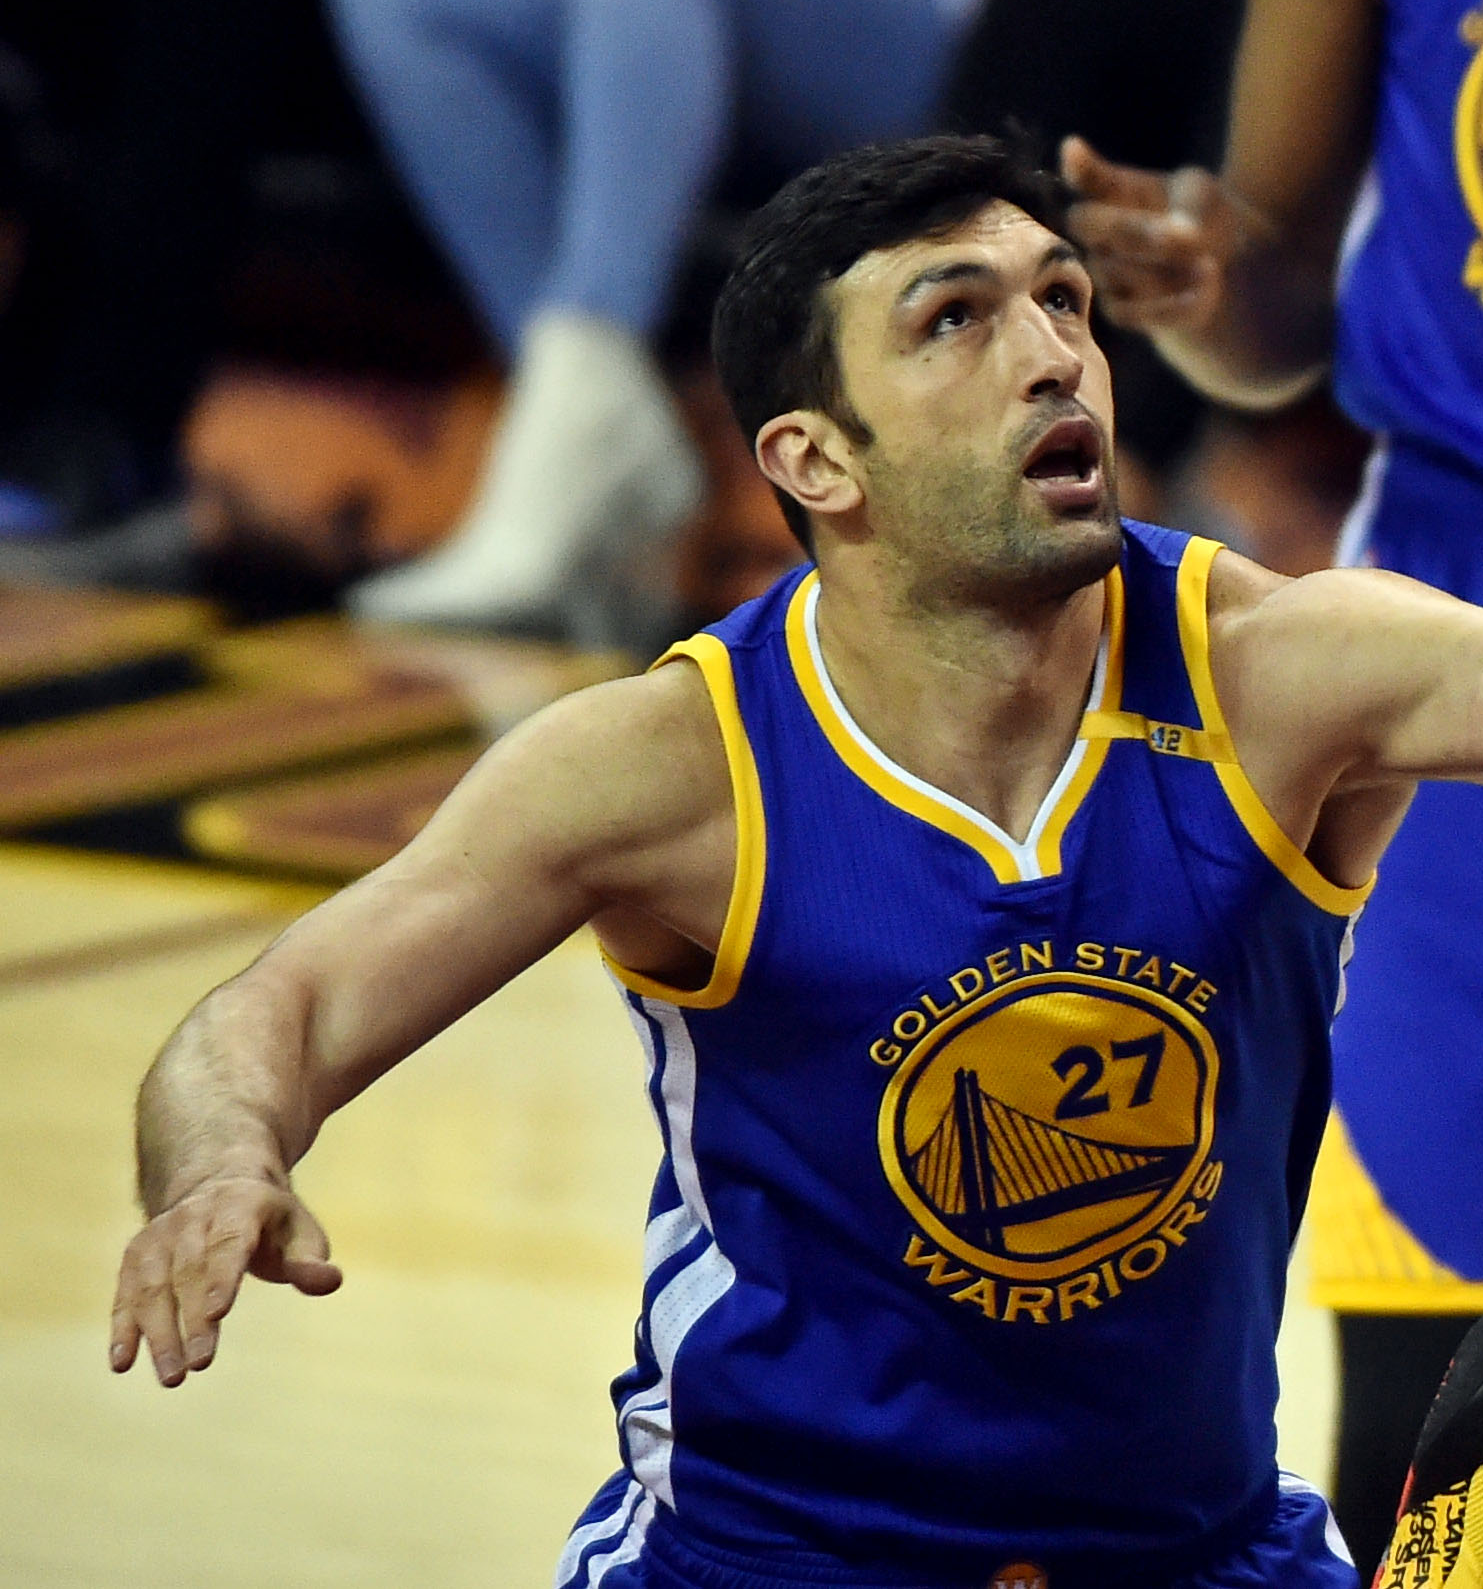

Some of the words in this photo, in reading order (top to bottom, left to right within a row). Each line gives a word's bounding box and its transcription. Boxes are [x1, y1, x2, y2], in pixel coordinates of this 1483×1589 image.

[1151, 727, 1182, 752] 42
[869, 940, 1054, 1066] GOLDEN
[1076, 942, 1217, 1013] STATE
[1050, 1029, 1166, 1120] 27
[903, 1161, 1223, 1324] WARRIORS
